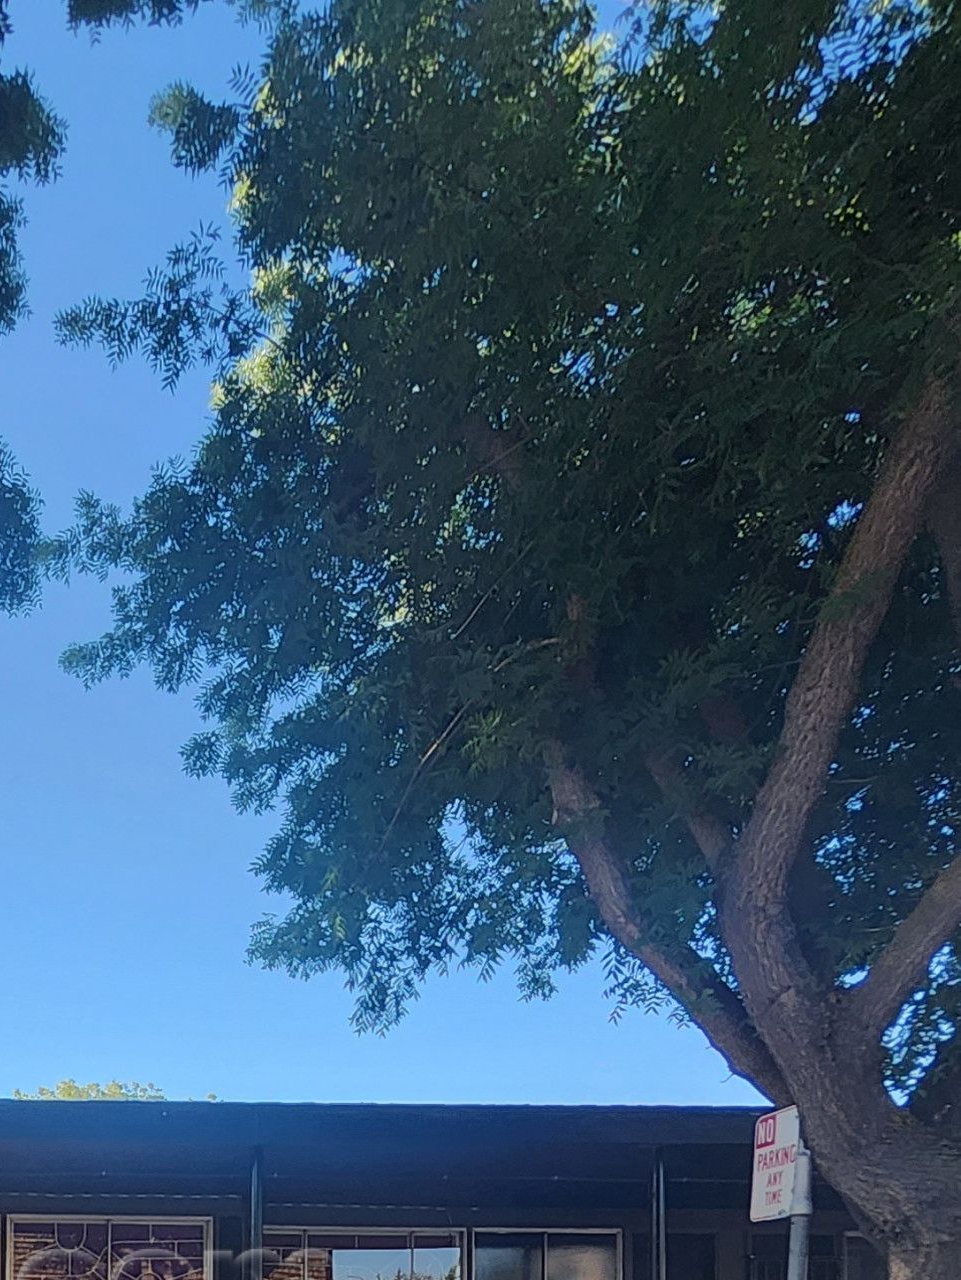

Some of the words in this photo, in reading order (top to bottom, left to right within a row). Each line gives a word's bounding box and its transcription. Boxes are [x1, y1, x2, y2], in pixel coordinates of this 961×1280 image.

[758, 1119, 774, 1144] NO
[758, 1145, 796, 1172] PARKING
[767, 1173, 782, 1187] ANY
[766, 1189, 782, 1205] TIME
